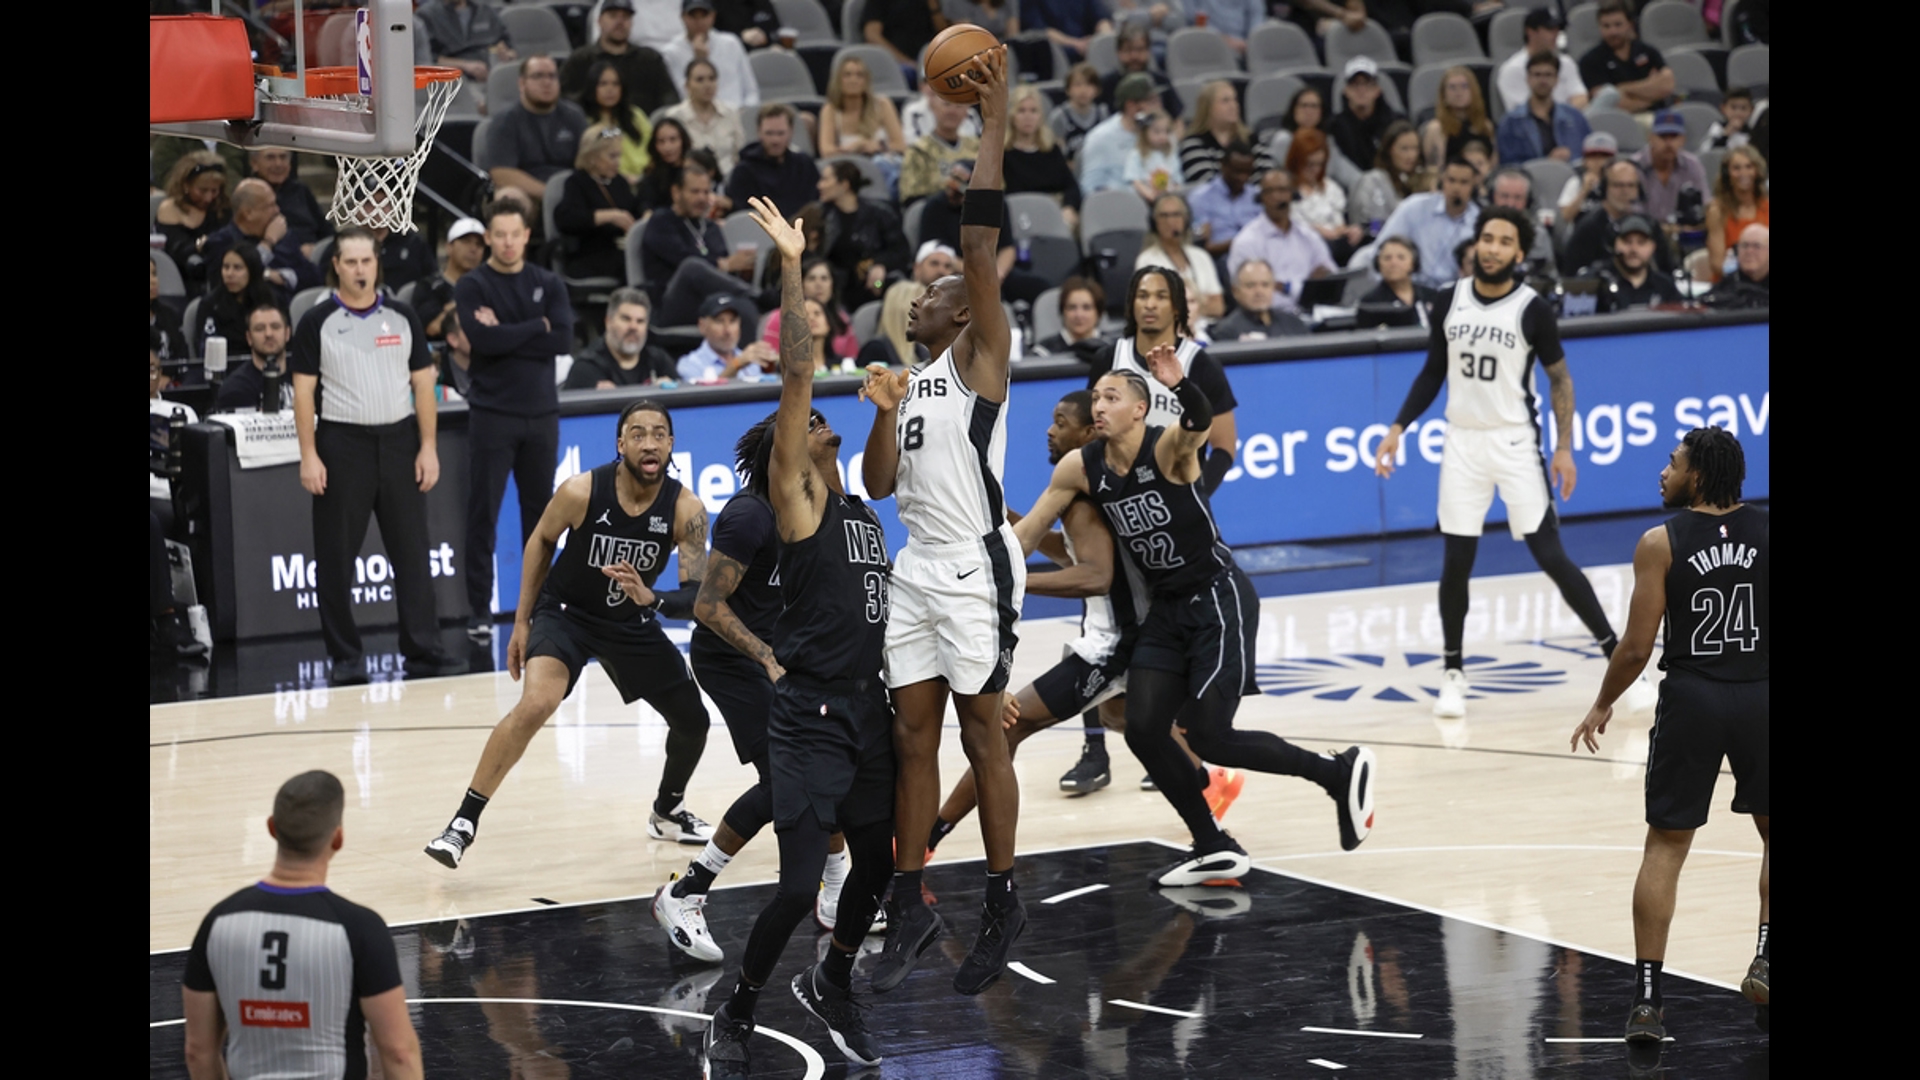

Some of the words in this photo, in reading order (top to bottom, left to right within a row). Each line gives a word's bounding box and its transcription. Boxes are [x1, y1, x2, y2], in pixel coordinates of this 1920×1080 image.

[1447, 323, 1517, 350] SPURS
[1460, 352, 1498, 382] 30
[1102, 490, 1171, 537] NETS
[587, 533, 660, 572] NETS
[843, 519, 888, 567] NET
[1130, 531, 1186, 569] 22
[1687, 542, 1758, 576] THOMAS
[1691, 583, 1759, 655] 24
[260, 931, 289, 990] 3
[244, 1005, 303, 1022] Emirates
